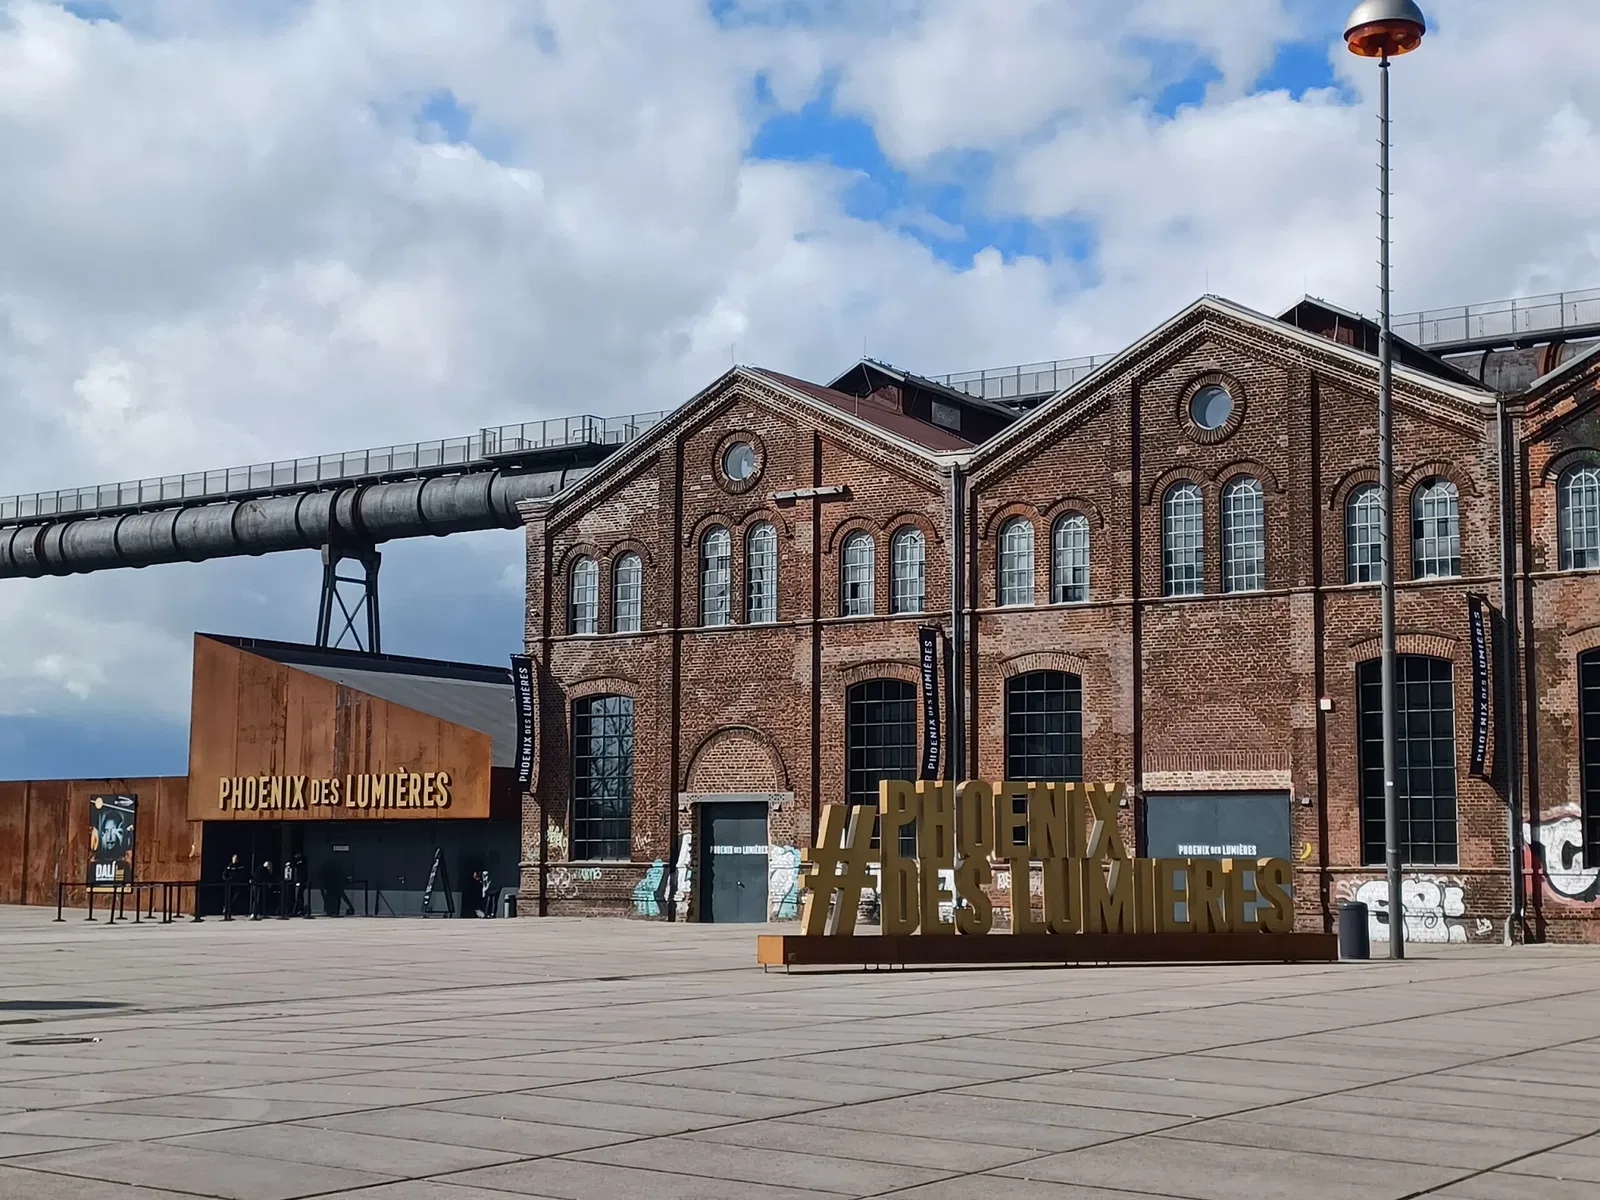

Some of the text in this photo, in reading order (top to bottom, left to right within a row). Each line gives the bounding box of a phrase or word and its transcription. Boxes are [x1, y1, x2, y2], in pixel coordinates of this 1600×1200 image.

[928, 719, 938, 769] PHOENIX
[1476, 702, 1488, 762] PHOENIX
[519, 736, 532, 782] PHOENIX
[219, 767, 450, 809] PHOENIX DES LUMIÈRES
[879, 780, 1126, 859] PHOENIX
[1178, 844, 1209, 855] PHOENIX
[880, 856, 992, 936] DES
